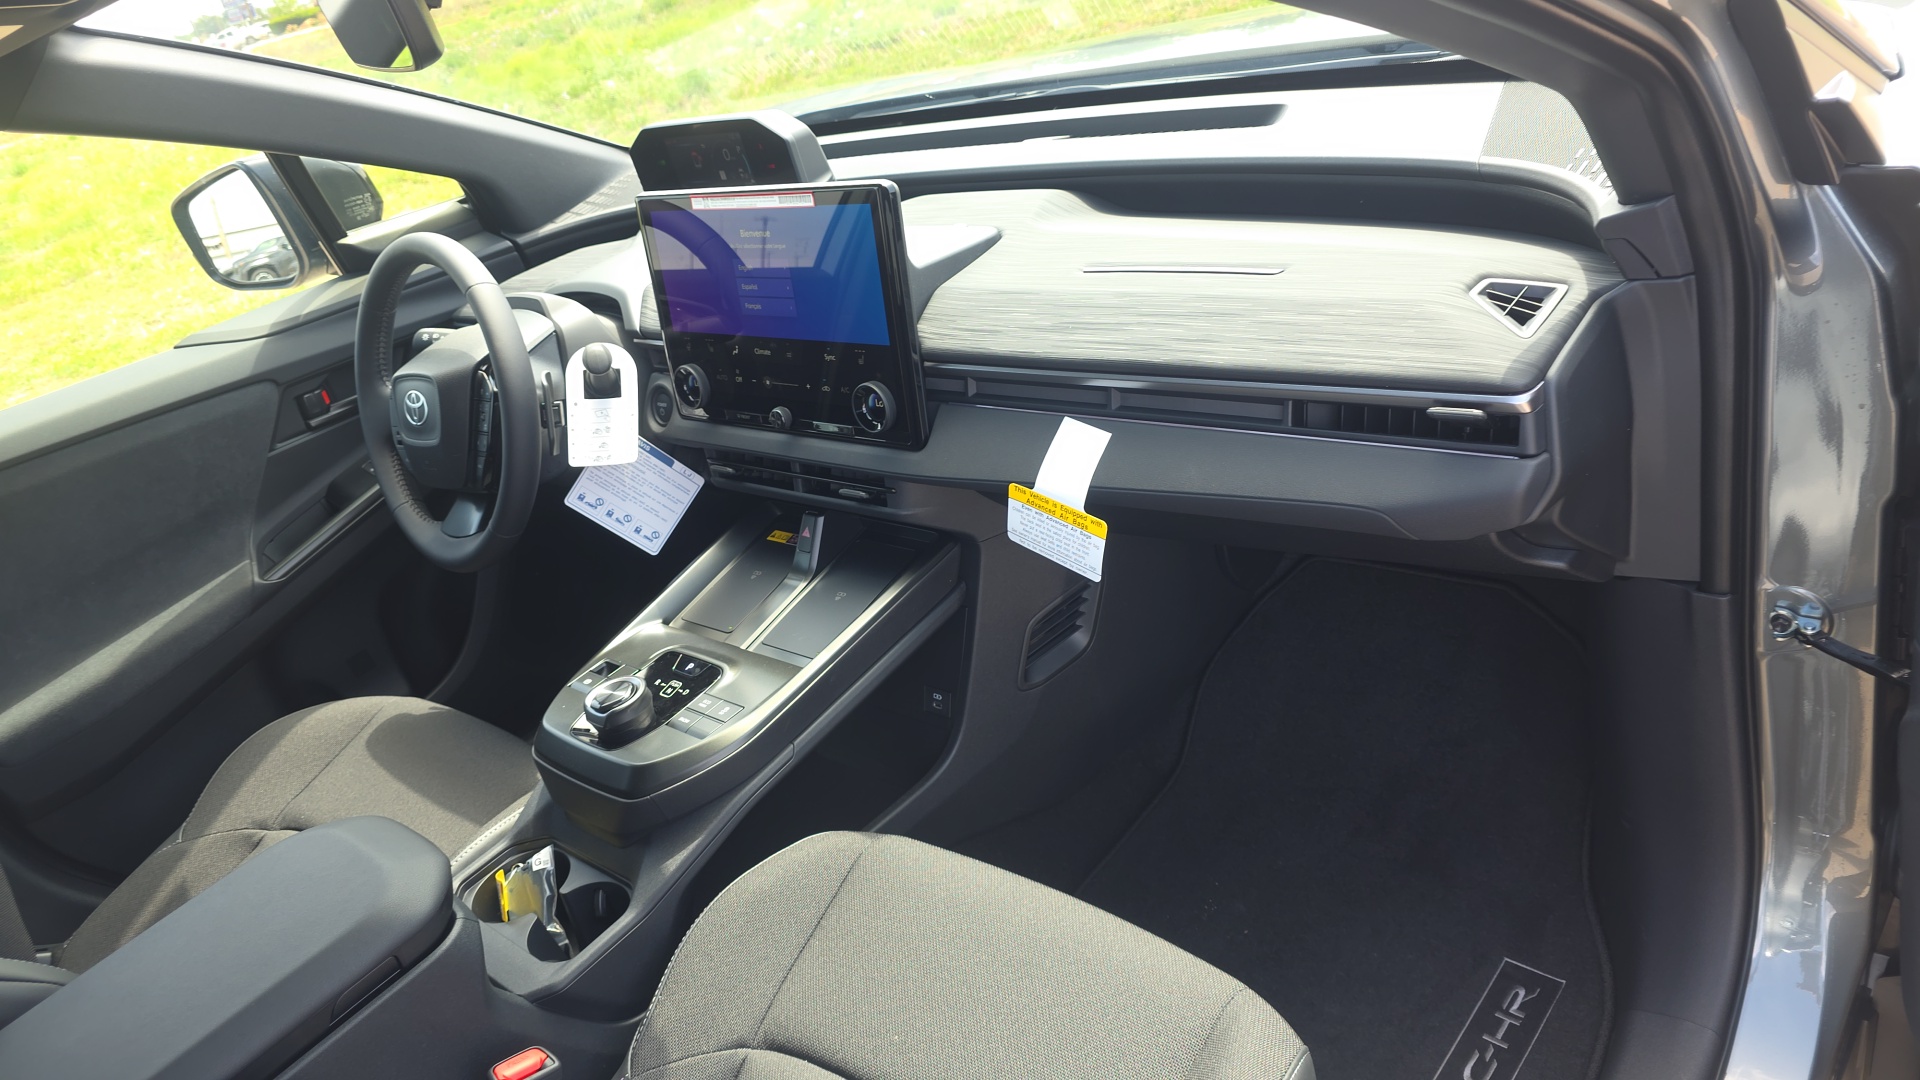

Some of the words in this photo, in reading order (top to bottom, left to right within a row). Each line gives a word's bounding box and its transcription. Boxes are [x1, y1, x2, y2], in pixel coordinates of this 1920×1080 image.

[739, 229, 771, 238] Bienvenue
[754, 348, 771, 356] Climate
[824, 353, 836, 361] Sync
[841, 386, 850, 394] A/C
[1014, 486, 1026, 495] This
[1030, 491, 1049, 504] Vehicle
[1060, 505, 1087, 521] Equipped
[1091, 520, 1103, 528] with
[1026, 498, 1056, 515] Advanced
[1073, 519, 1088, 530] Bags
[1046, 516, 1068, 529] Advanced
[1080, 530, 1092, 539] Bags
[685, 662, 695, 671] P
[654, 678, 662, 686] R
[682, 688, 690, 696] D
[534, 857, 542, 866] G
[1463, 985, 1541, 1080] C-HR
